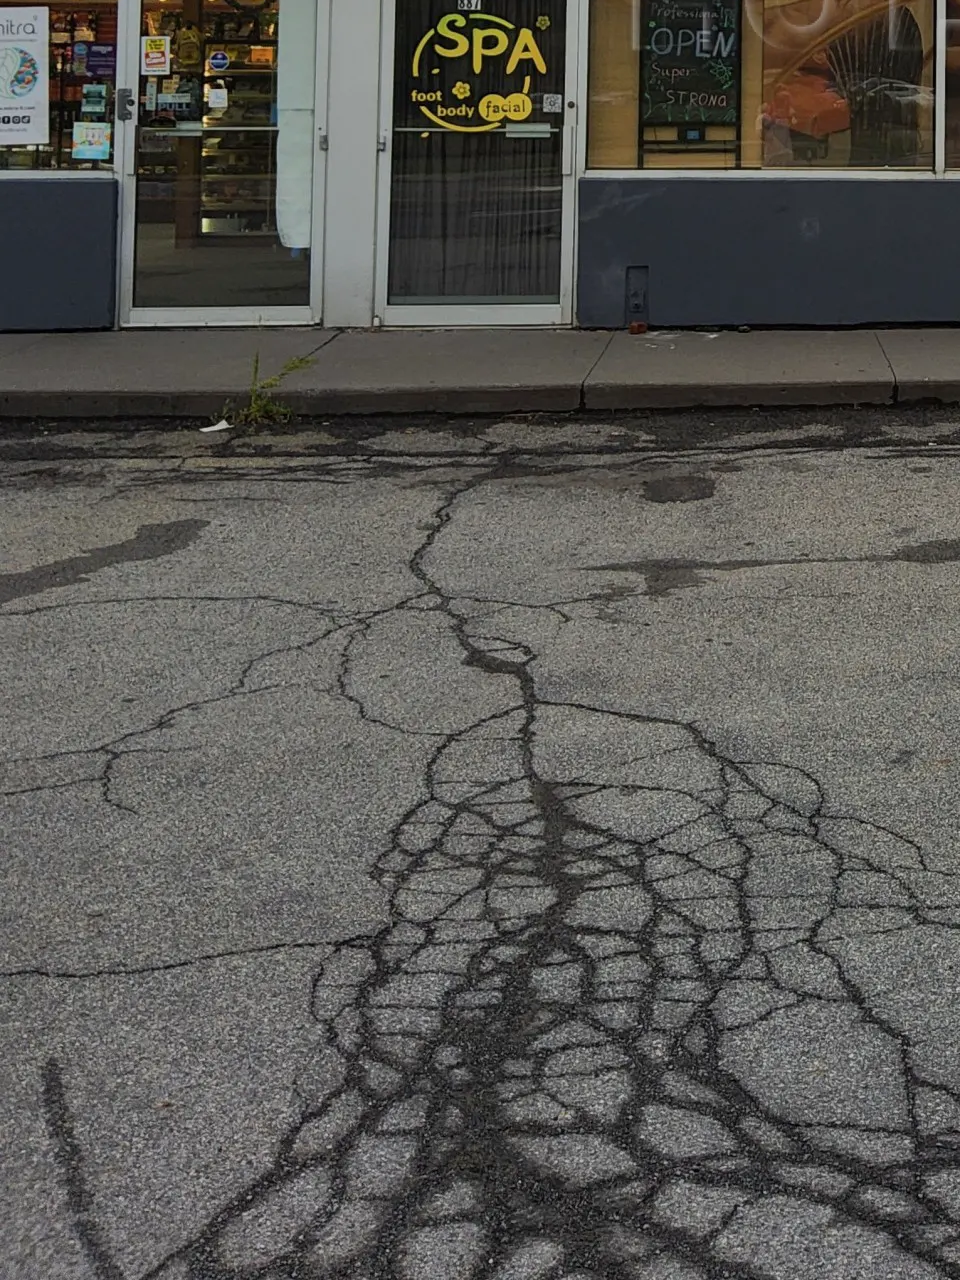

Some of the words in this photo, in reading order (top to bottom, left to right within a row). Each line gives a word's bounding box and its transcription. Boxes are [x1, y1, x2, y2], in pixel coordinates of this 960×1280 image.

[651, 2, 724, 20] Professional
[651, 27, 735, 58] OPEN
[651, 62, 690, 84] Super
[410, 90, 443, 102] foot
[437, 104, 475, 118] body
[485, 100, 526, 118] facial
